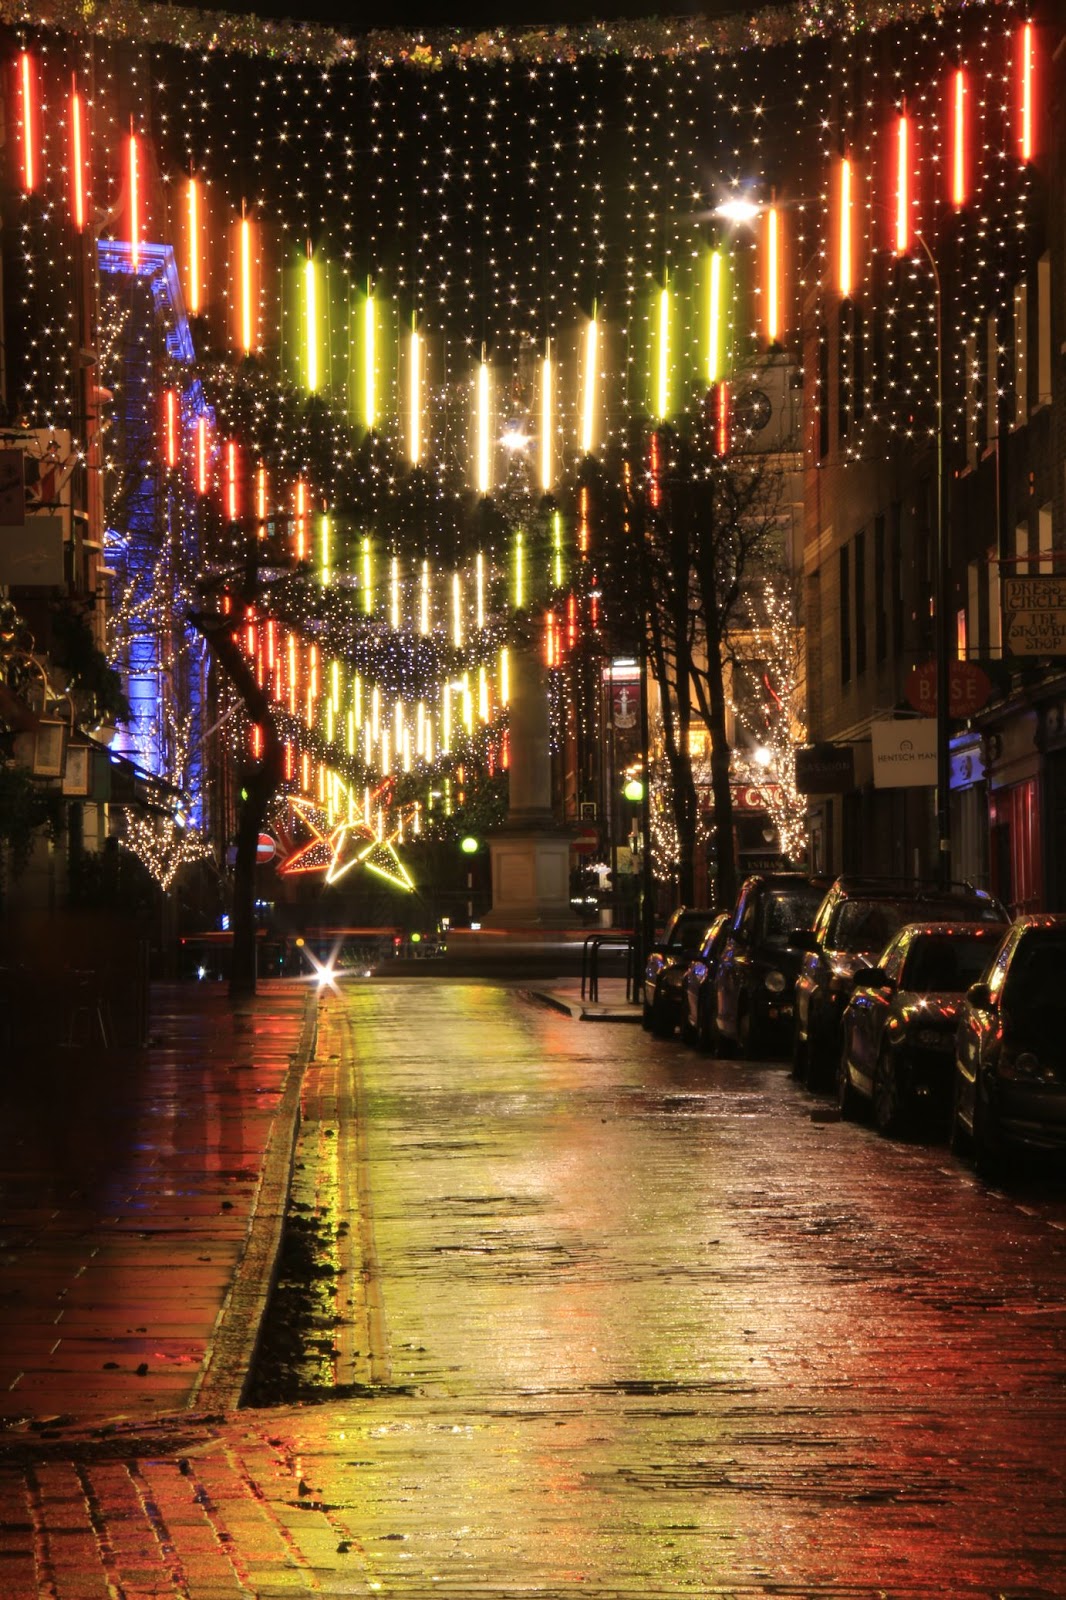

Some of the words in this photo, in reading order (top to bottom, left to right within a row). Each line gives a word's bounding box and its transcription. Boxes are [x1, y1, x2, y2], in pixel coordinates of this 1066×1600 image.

[1010, 582, 1061, 595] DRESS
[1010, 595, 1066, 608] CIRCLE
[1031, 613, 1056, 624] THE
[1025, 637, 1061, 649] SHOP
[920, 678, 976, 700] BSE
[918, 752, 937, 760] MAN
